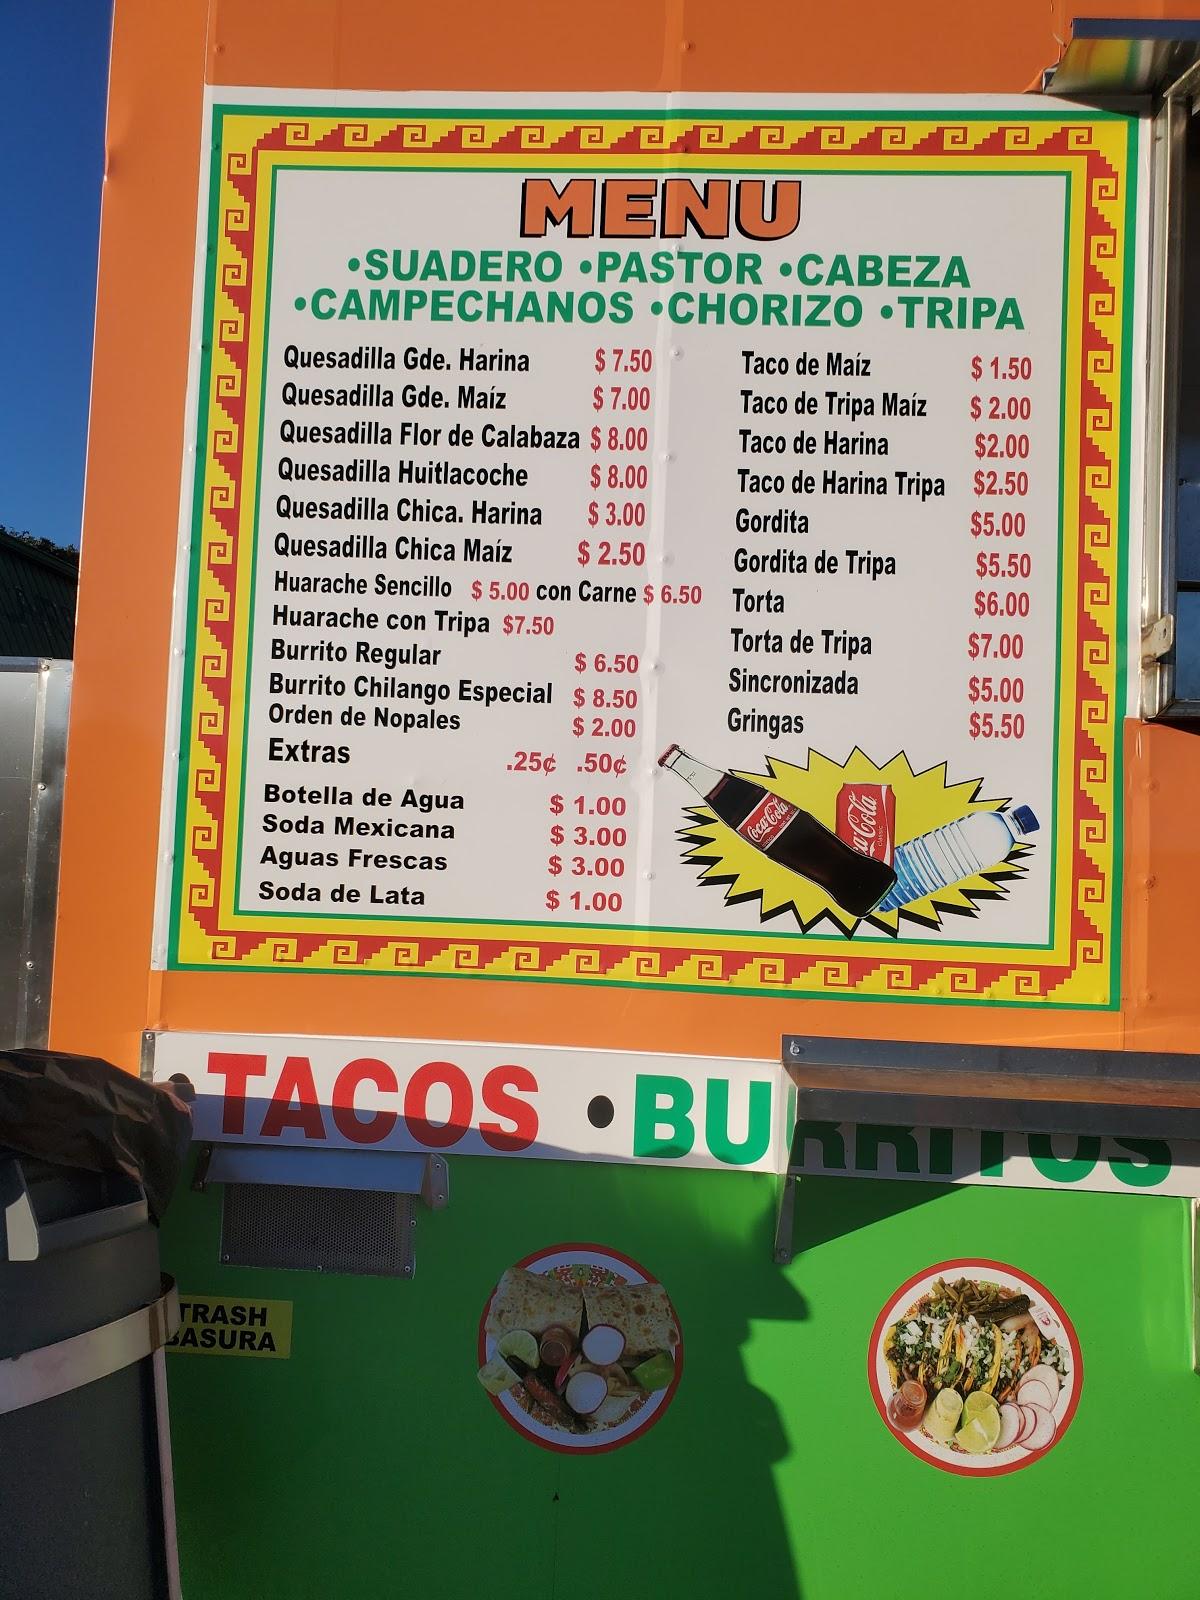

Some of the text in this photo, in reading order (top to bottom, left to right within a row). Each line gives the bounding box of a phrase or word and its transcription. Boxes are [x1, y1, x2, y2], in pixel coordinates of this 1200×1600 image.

[519, 177, 802, 241] MENU
[284, 345, 395, 369] Quesadilla
[404, 347, 450, 370] Gde.
[460, 348, 529, 371] Harina
[612, 348, 652, 373] 7.50
[742, 351, 788, 375] Taco
[796, 352, 819, 375] de
[827, 352, 870, 376] Maíz
[991, 356, 1033, 381] 1.50
[282, 382, 393, 407] Quesadilla
[402, 385, 449, 408] Gde.
[458, 386, 506, 409] Maíz
[611, 385, 651, 412] 7.00
[741, 390, 787, 414] Taco
[795, 391, 817, 414] de
[825, 392, 874, 421] Tripa
[883, 393, 926, 416] Maíz
[988, 396, 1031, 421] 2.00
[280, 420, 391, 444] Quesadilla
[400, 423, 441, 445] Flor
[449, 424, 473, 446] de
[482, 424, 579, 449] Calabaza
[608, 426, 648, 452] 8.00
[739, 429, 1031, 459] Taco de Harina $2.00
[279, 457, 390, 482] Quesadilla
[399, 460, 528, 486] Huitlacoche
[607, 464, 648, 489] 8.00
[738, 469, 1028, 502] Taco de Harina Tripa $2.50
[277, 495, 388, 520] Quesadilla
[397, 498, 463, 523] Chica.
[472, 501, 541, 525] Harina
[605, 501, 646, 528] 3.00
[736, 508, 1026, 538] Gordita $5.00
[275, 533, 386, 558] Quesadilla
[396, 536, 455, 561] Chica
[464, 539, 512, 562] Maíz
[597, 541, 646, 566] 2.50
[734, 548, 1031, 580] Gordita de Tripa $5.50
[275, 571, 367, 594] Huarache
[375, 574, 451, 597] Sencillo
[489, 580, 529, 602] 5.00
[537, 585, 571, 601] con
[579, 580, 636, 602] Carne
[660, 584, 703, 605] 6.50
[733, 588, 1030, 617] Torta $6.00
[273, 605, 554, 637] Huarache con Tripa $7.50
[272, 639, 347, 661] Burrito
[356, 642, 441, 669] Regular
[594, 653, 639, 673] 6.50
[731, 628, 1024, 660] Torta de Tripa $7.00
[270, 673, 345, 696] Burrito
[354, 676, 450, 705] Chilango
[459, 680, 552, 707] Especial
[592, 688, 638, 709] 8.50
[729, 668, 1024, 704] Sincronizada $5.00
[269, 703, 332, 724] Orden
[341, 706, 365, 726] de
[375, 707, 460, 733] Nopales
[591, 717, 636, 737] 2.00
[728, 708, 1025, 740] Gringas $5.50
[269, 738, 628, 777] Extras .25¢ .50¢
[265, 784, 352, 805] Botella
[363, 788, 392, 806] de
[401, 789, 463, 813] Agua
[575, 795, 626, 816] 1.00
[263, 814, 324, 834] Soda
[335, 817, 454, 838] Mexicana
[575, 826, 628, 847] 3.00
[260, 846, 338, 870] Aguas
[349, 849, 447, 870] Frescas
[572, 856, 625, 879] 3.00
[259, 881, 320, 901] Soda
[331, 884, 360, 902] de
[371, 885, 424, 905] Lata
[570, 891, 622, 912] 1.00
[208, 1052, 538, 1151] TACOS
[180, 1303, 267, 1327] TRASH
